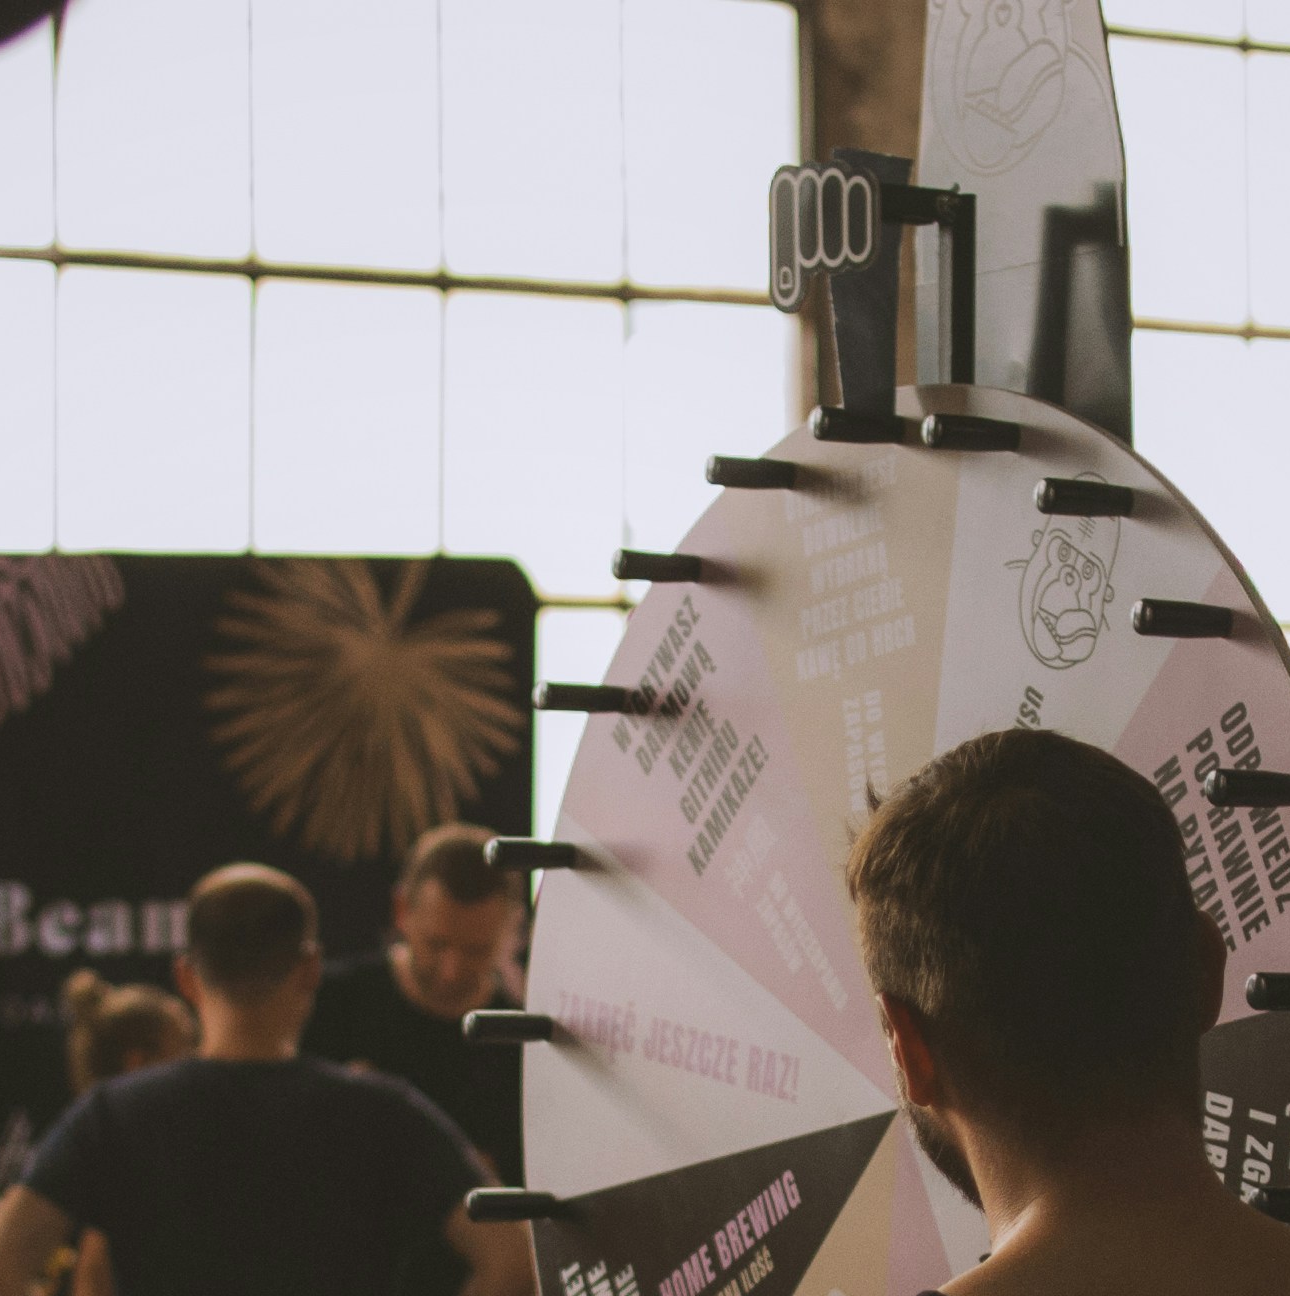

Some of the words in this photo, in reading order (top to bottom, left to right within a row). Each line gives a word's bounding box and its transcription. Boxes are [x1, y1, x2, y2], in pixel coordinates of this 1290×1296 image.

[635, 639, 717, 776] DARMOWĄ
[680, 718, 739, 825] GITHIRU
[687, 733, 770, 876] KAMIKAZE!
[1153, 755, 1188, 809] NA
[1186, 728, 1271, 942] PORAWNIE
[643, 1015, 739, 1087] JESZCZE
[745, 1042, 801, 1105] RAZ!
[1202, 1091, 1234, 1183] DAR
[713, 1169, 802, 1271] BREWING
